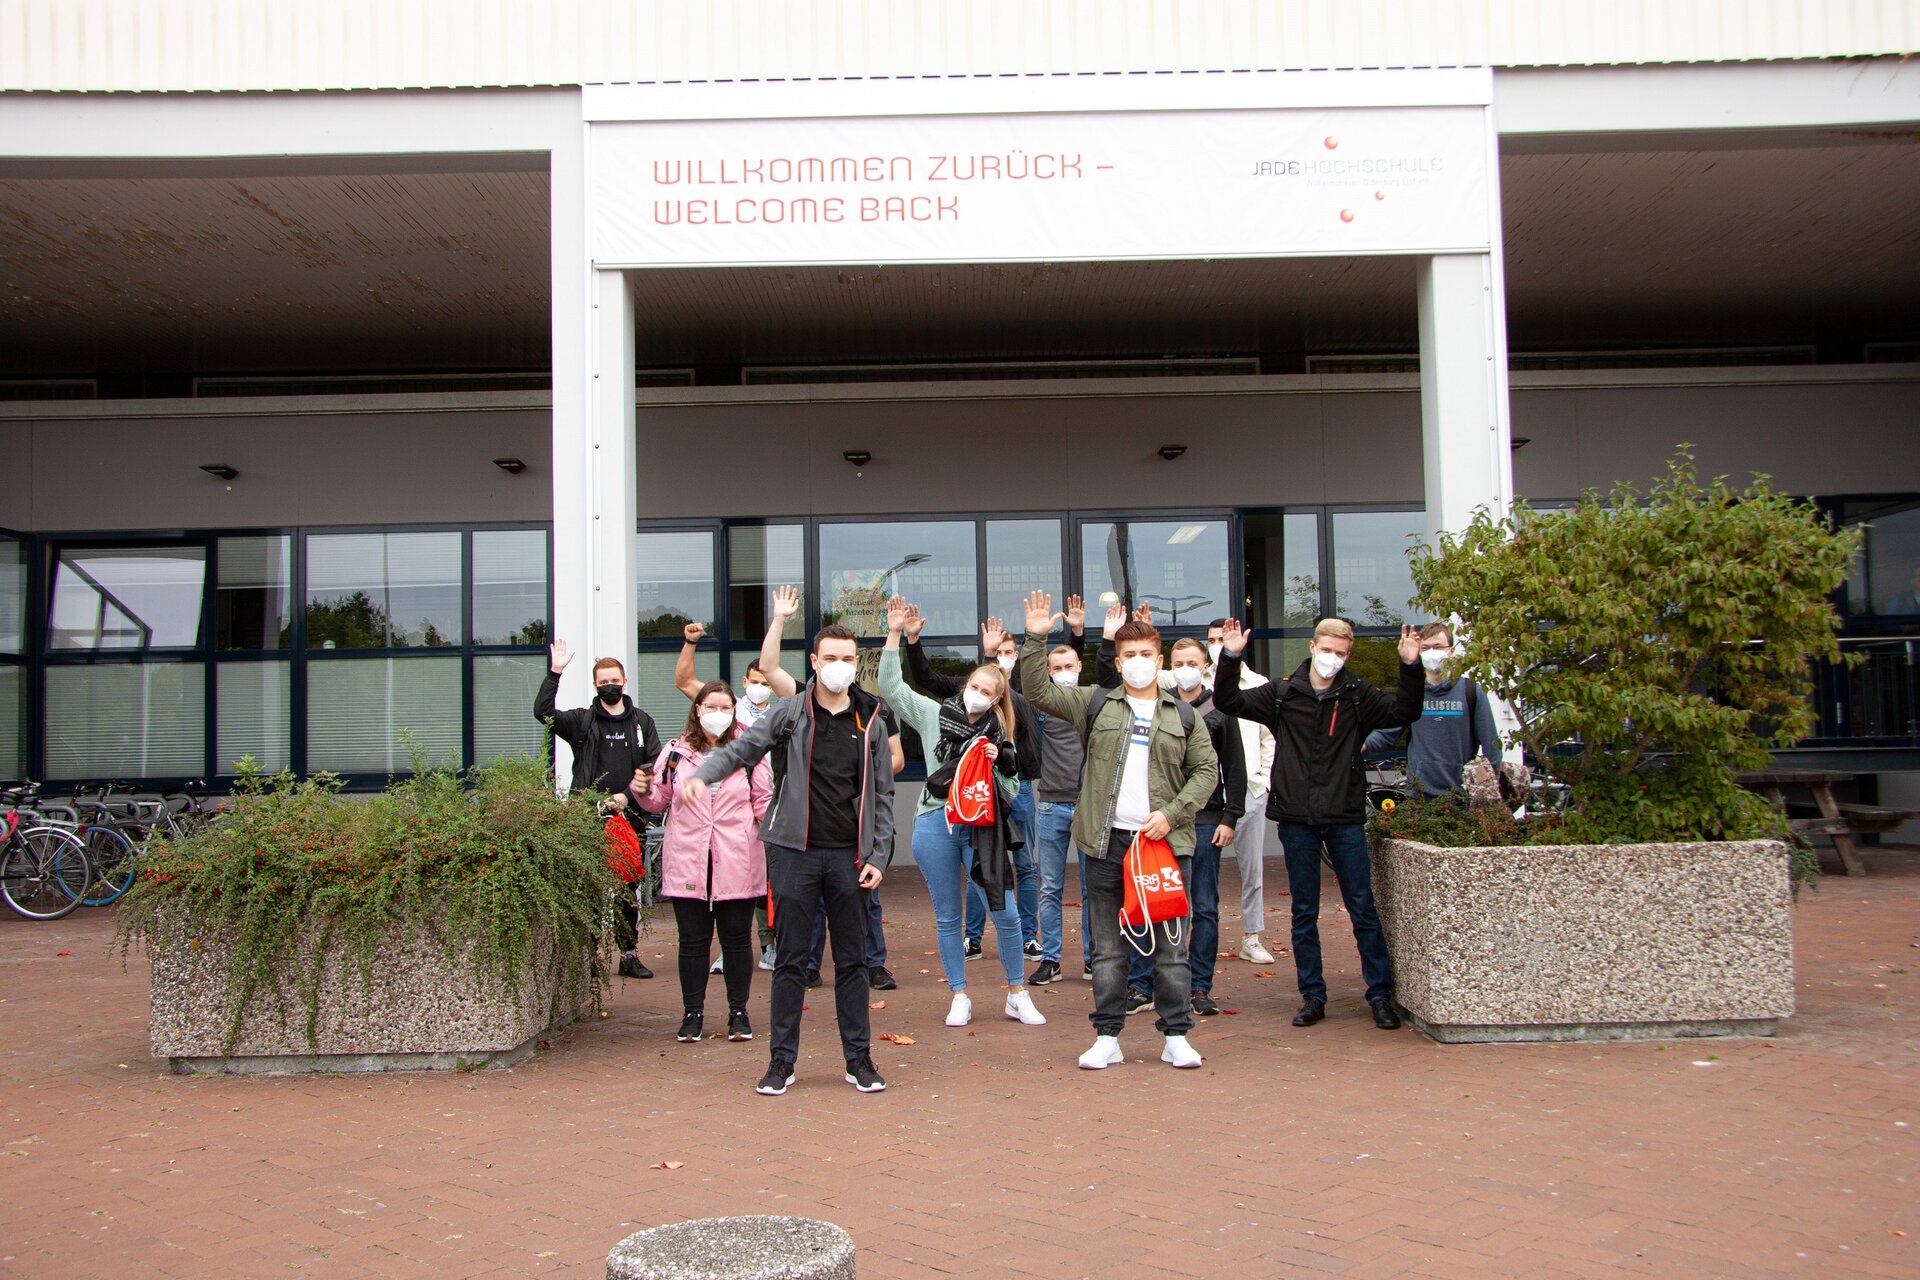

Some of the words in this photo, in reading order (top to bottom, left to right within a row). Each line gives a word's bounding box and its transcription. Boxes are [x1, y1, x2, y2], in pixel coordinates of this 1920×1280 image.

[653, 157, 912, 185] WILLKOMMEN
[927, 149, 1082, 180] ZURÜCK
[1251, 160, 1300, 176] JADE
[1303, 157, 1445, 175] HOCHSCHULE
[653, 197, 845, 224] WELCOME
[860, 196, 959, 221] BACK
[1160, 866, 1184, 885] TK
